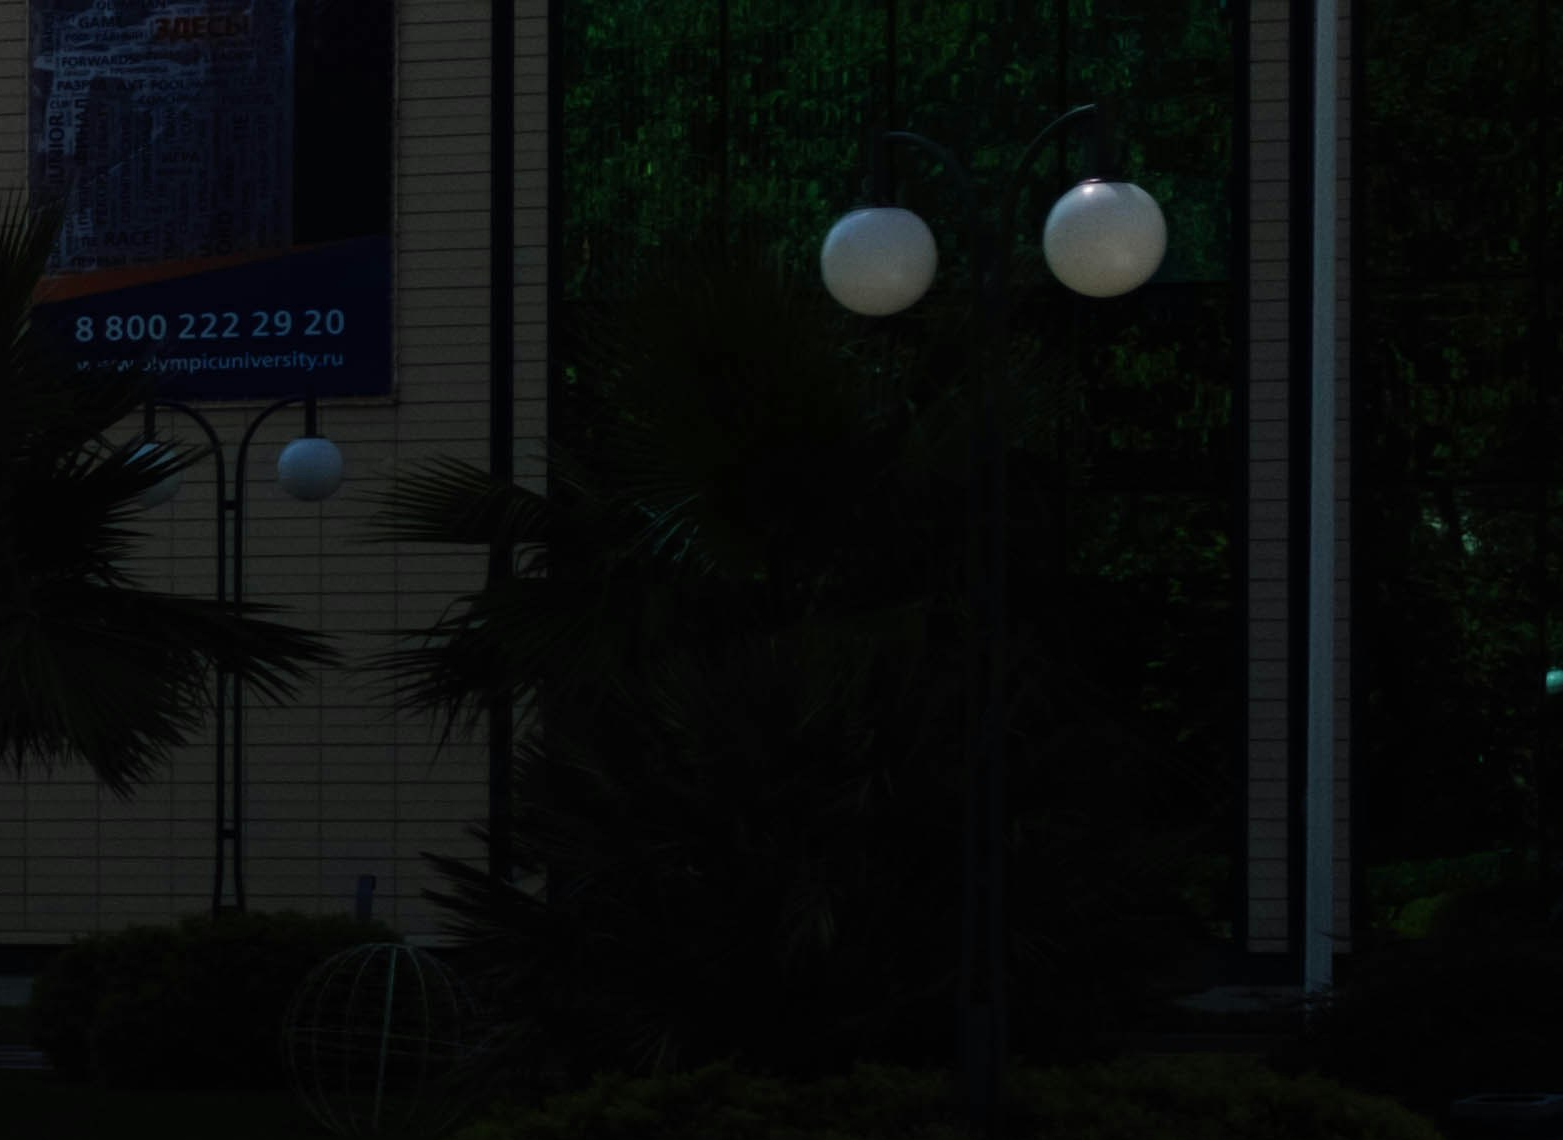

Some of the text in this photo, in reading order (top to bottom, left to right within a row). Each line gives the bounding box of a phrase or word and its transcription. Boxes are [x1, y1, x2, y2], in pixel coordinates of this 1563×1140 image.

[74, 308, 346, 343] 8 800 222 29 20
[75, 350, 345, 377] lympicuniversity.ru
